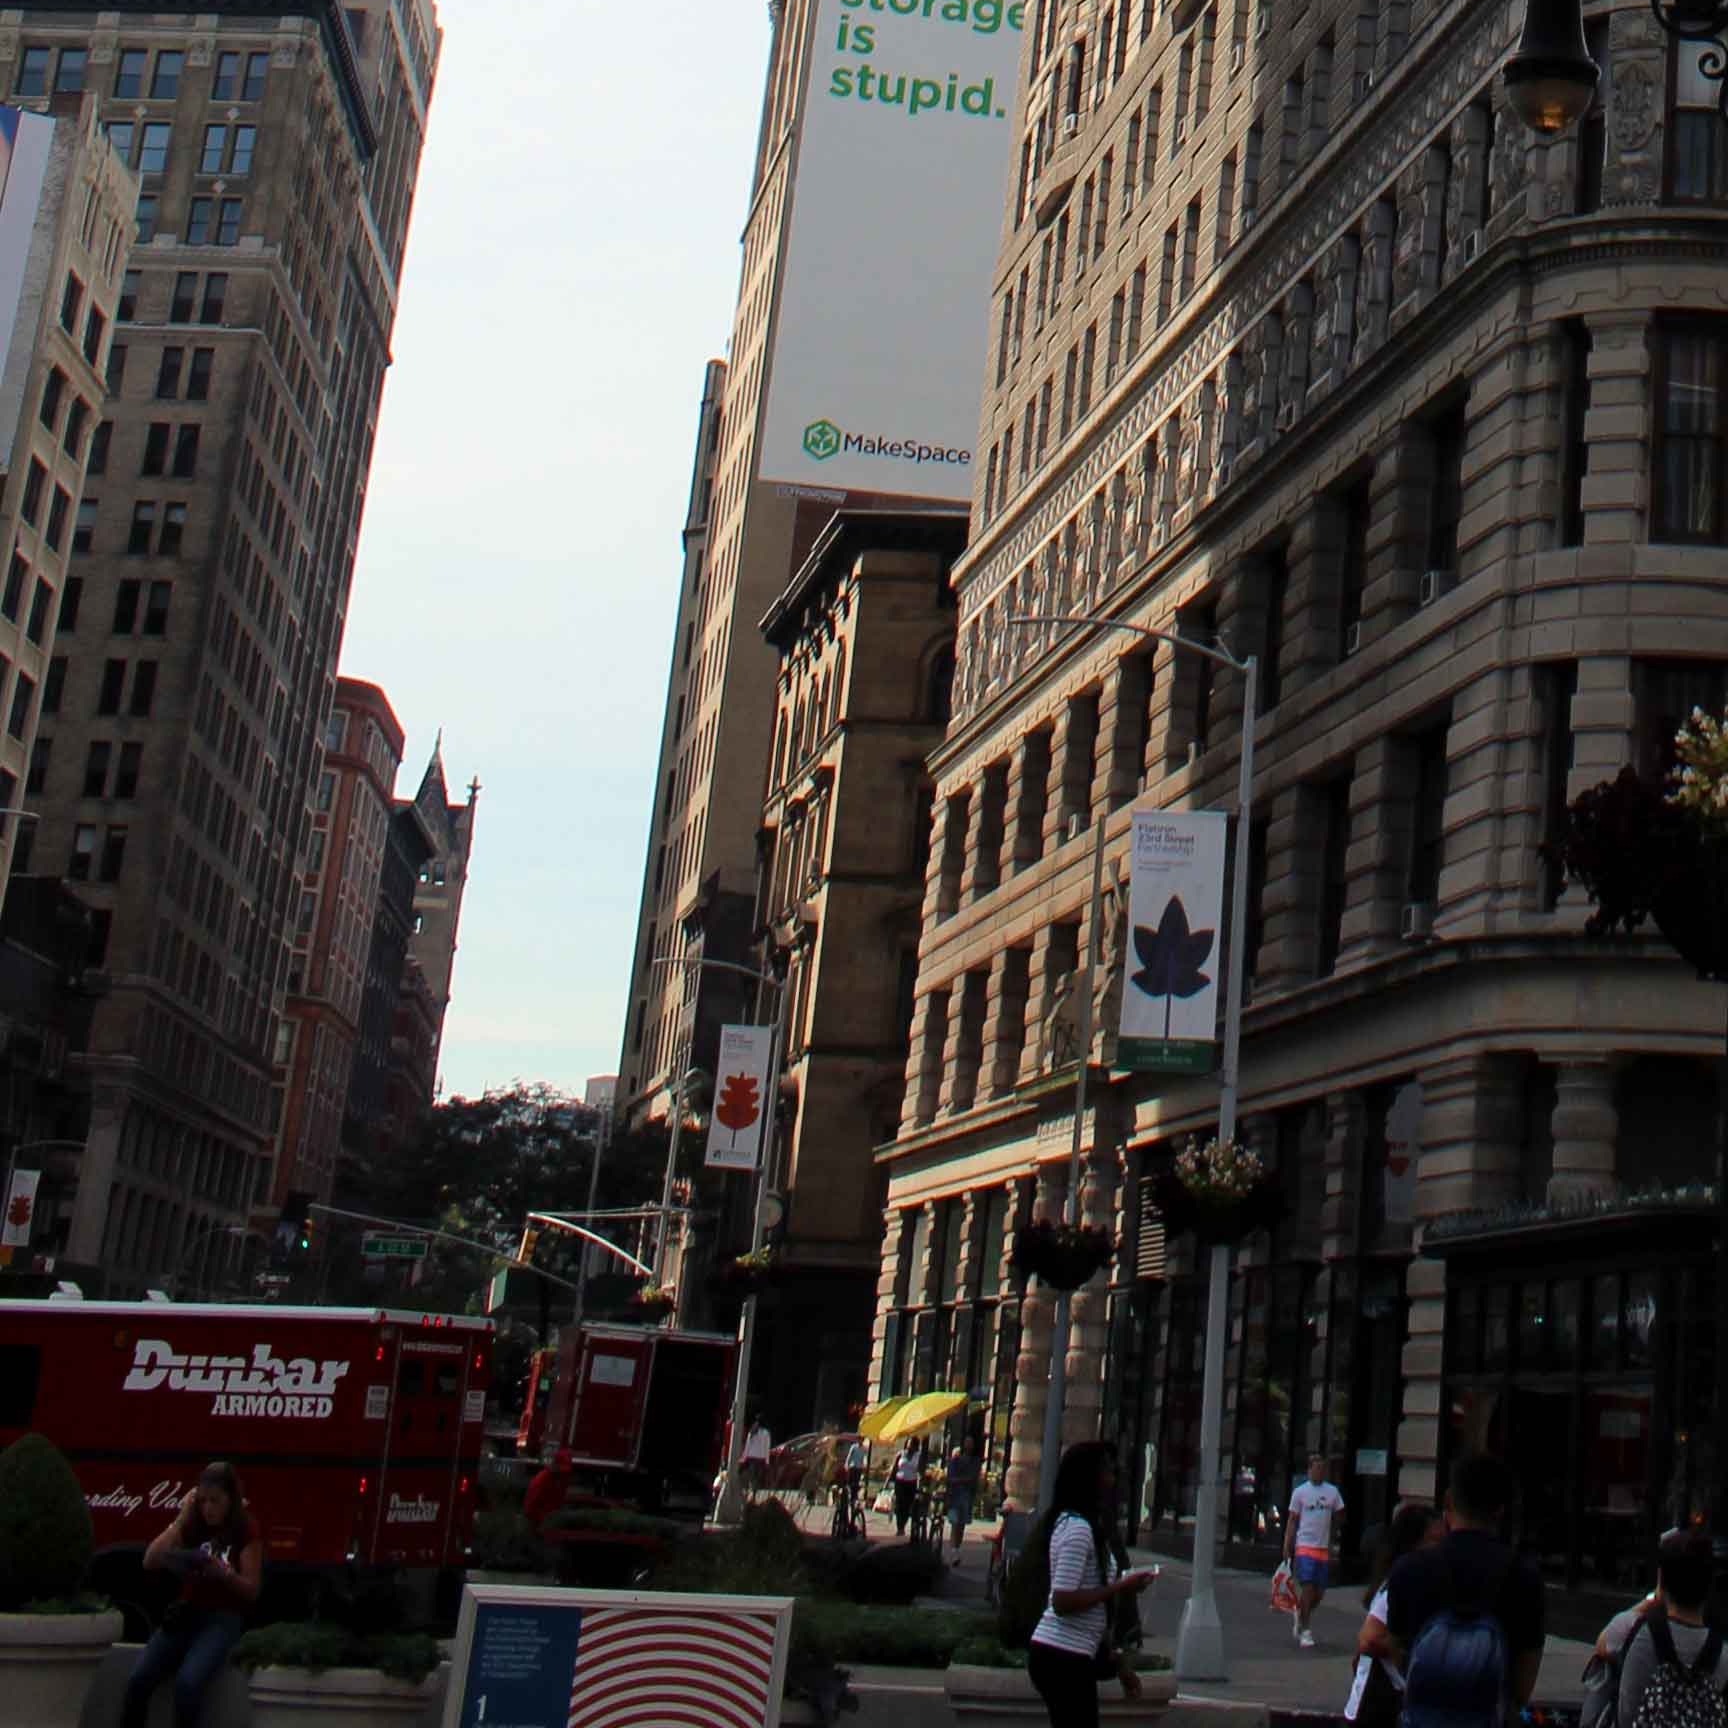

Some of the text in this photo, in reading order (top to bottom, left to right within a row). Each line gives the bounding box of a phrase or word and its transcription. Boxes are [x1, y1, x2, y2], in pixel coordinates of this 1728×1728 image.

[836, 13, 875, 55] is
[830, 63, 1006, 118] stupid.
[843, 433, 971, 464] MakeSpace
[122, 1338, 351, 1394] Dunbar
[210, 1393, 335, 1419] ARMORED
